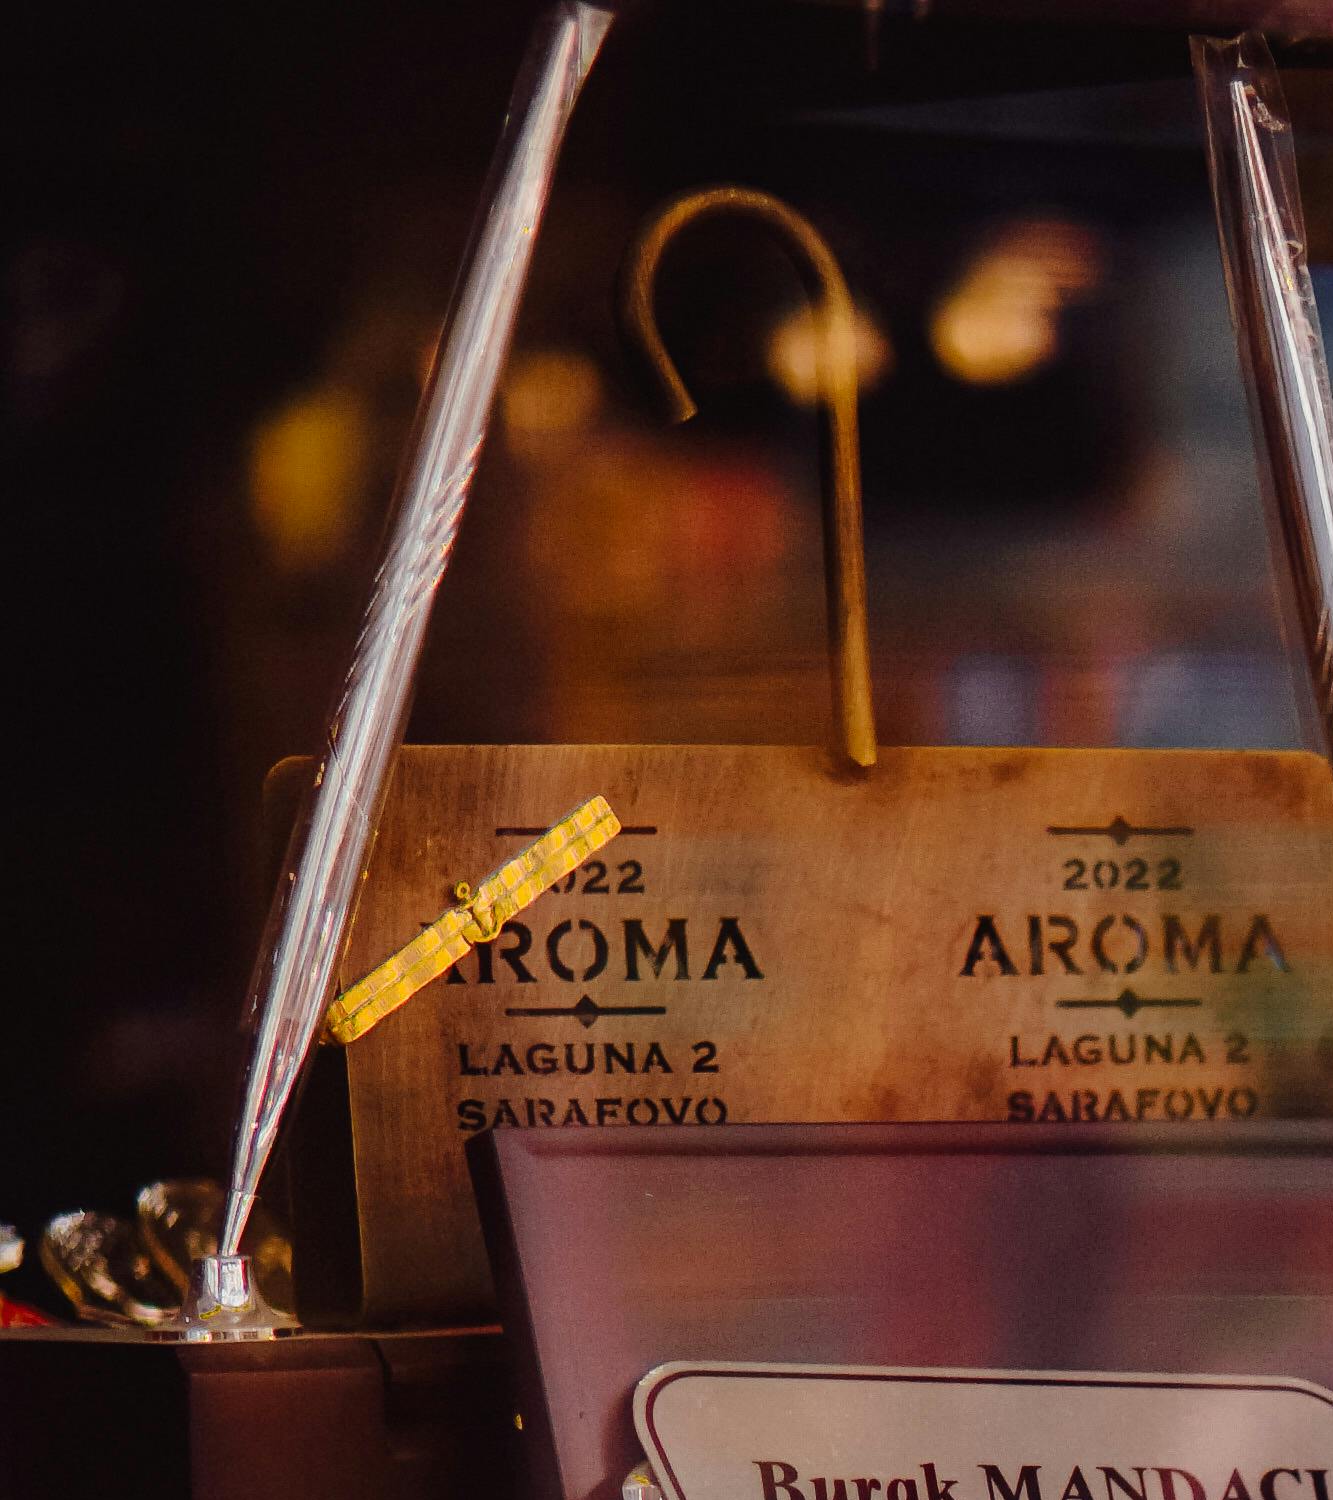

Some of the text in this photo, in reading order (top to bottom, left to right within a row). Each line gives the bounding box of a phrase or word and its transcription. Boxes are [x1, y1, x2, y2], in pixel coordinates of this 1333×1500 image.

[1062, 857, 1184, 891] 2022
[959, 913, 1294, 978] AROMA
[458, 1041, 720, 1077] LAGUNA 2
[1009, 1031, 1250, 1068] LAGUNA 2
[457, 1097, 729, 1131] SARAFOVO
[1007, 1087, 1259, 1122] SARAFOVO
